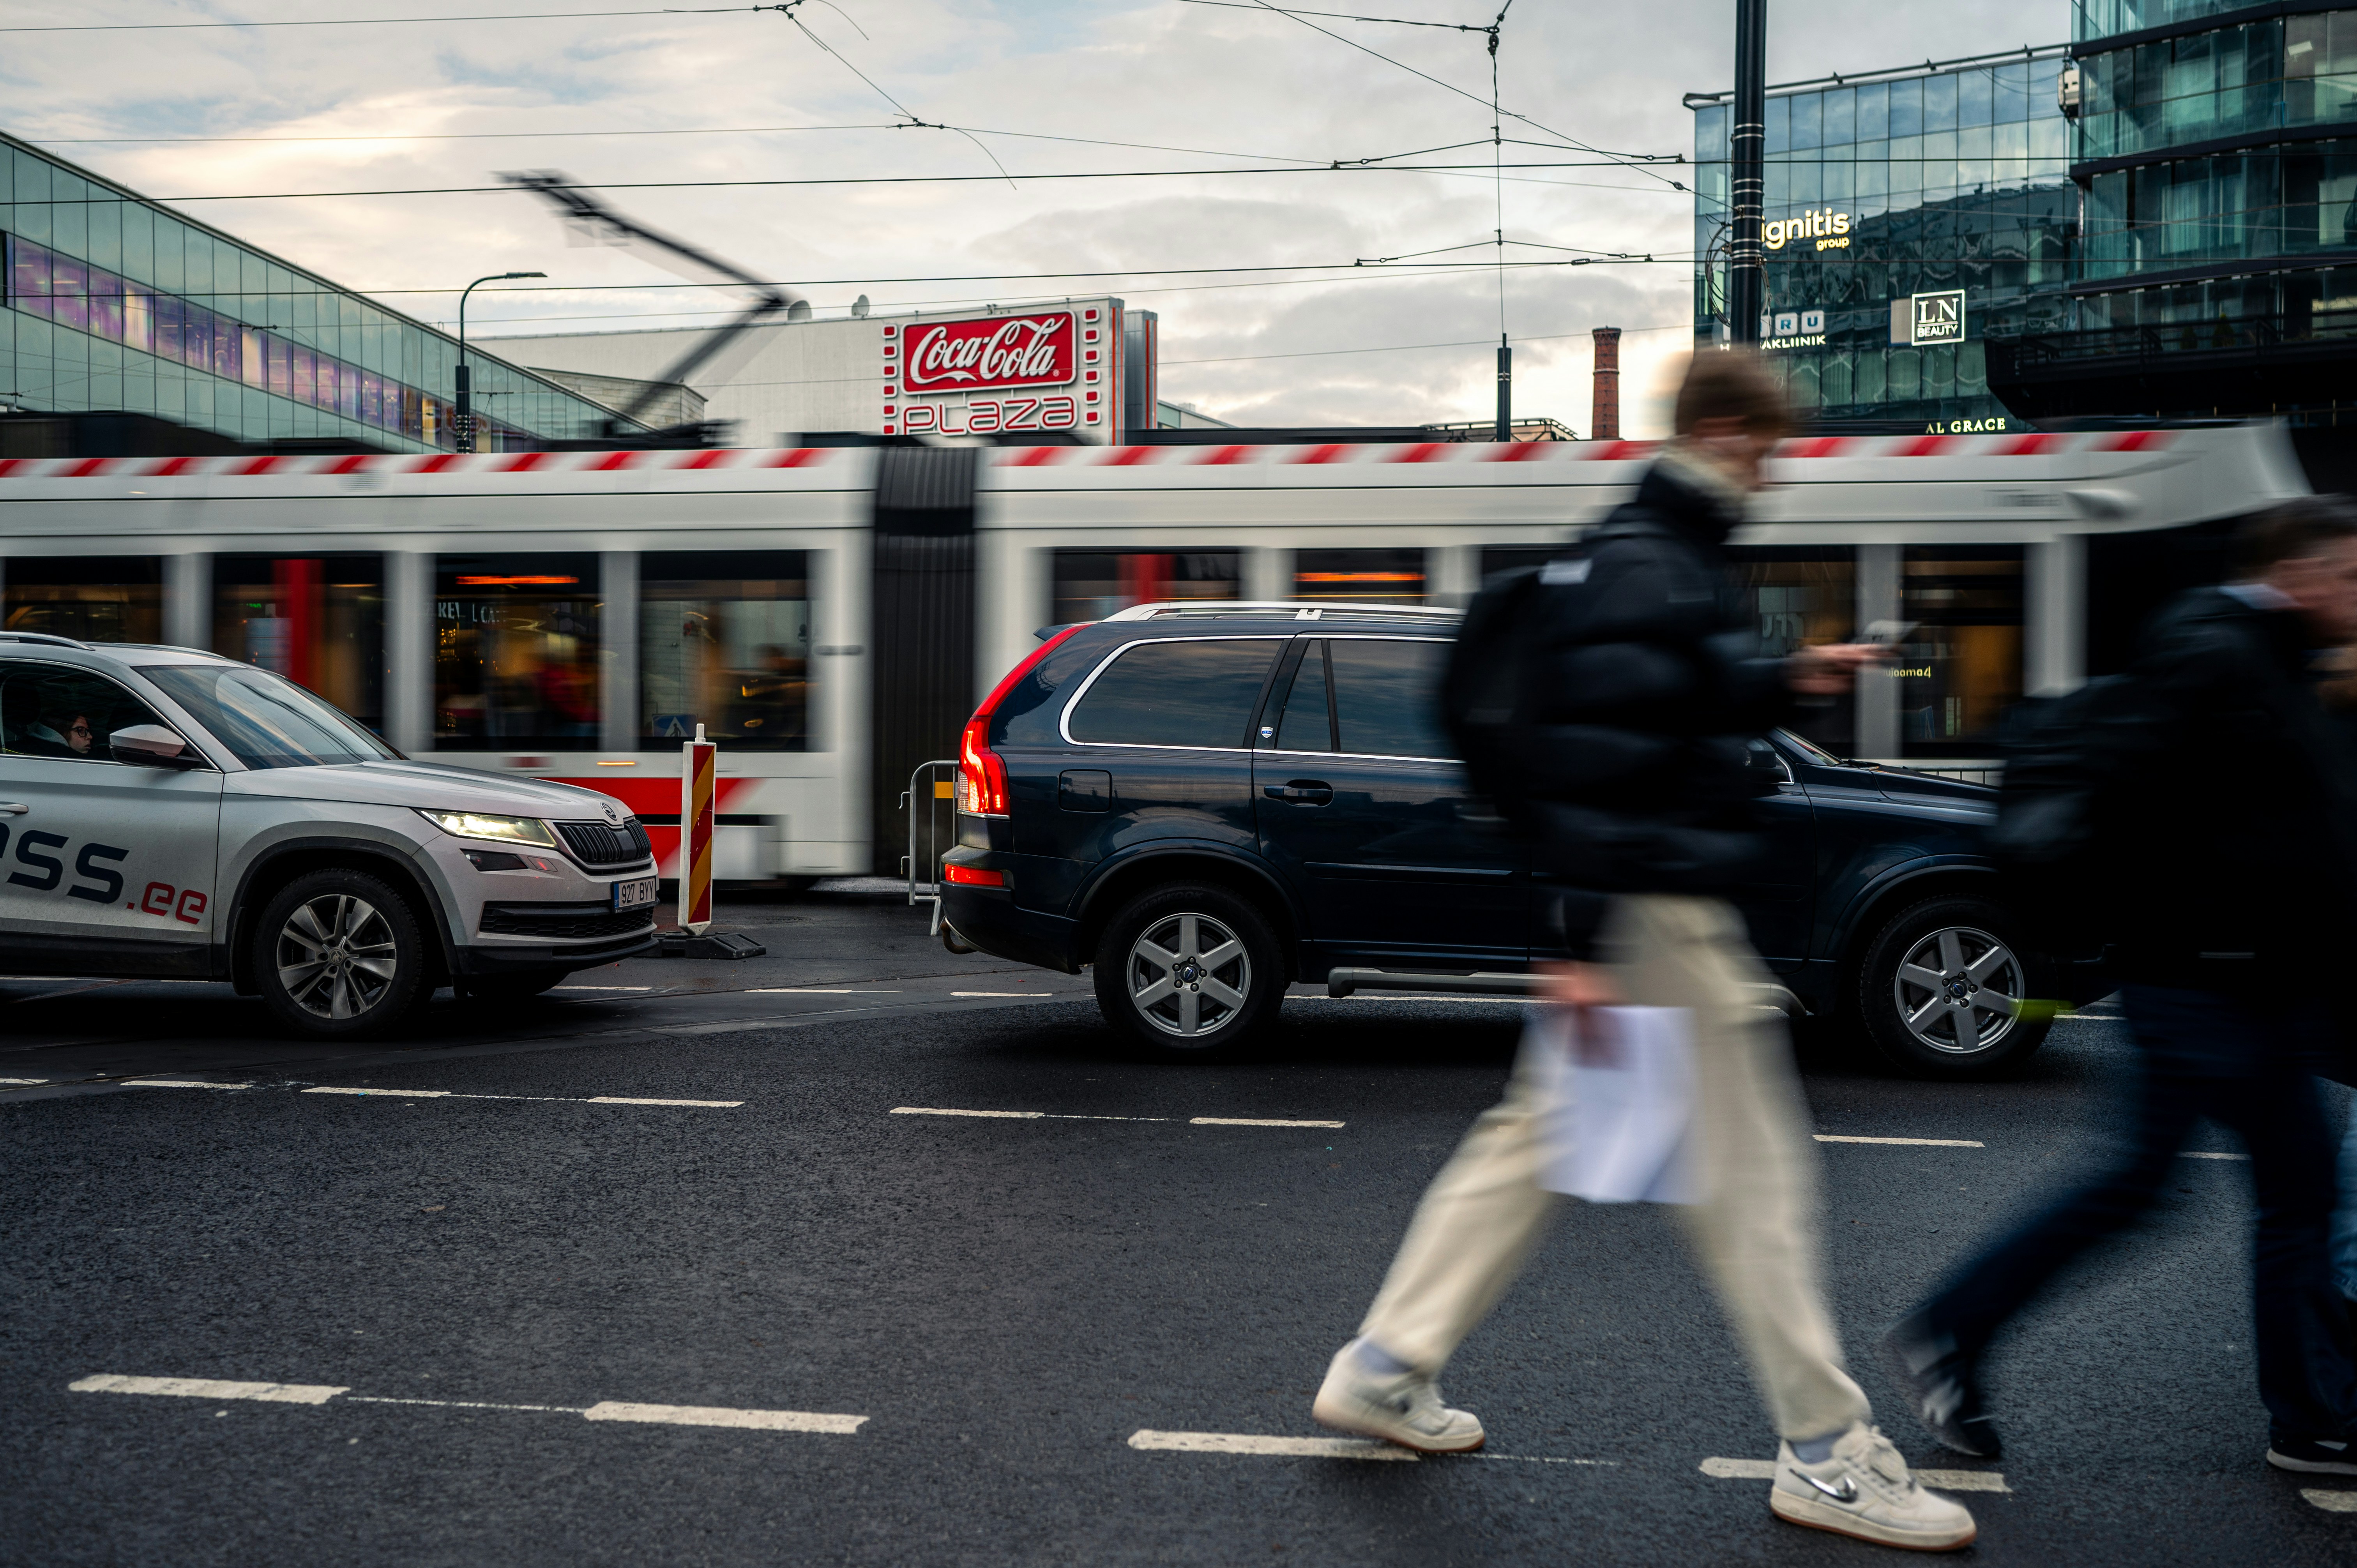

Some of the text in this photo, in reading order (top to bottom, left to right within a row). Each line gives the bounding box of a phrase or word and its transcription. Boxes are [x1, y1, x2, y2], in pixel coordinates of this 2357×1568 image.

[1816, 237, 1850, 251] group
[1918, 298, 1959, 323] LN
[1917, 324, 1958, 337] BEAUTY
[910, 316, 1066, 384] Coca-Cola
[1951, 418, 2005, 433] GRACE
[622, 881, 654, 904] 927 BYY
